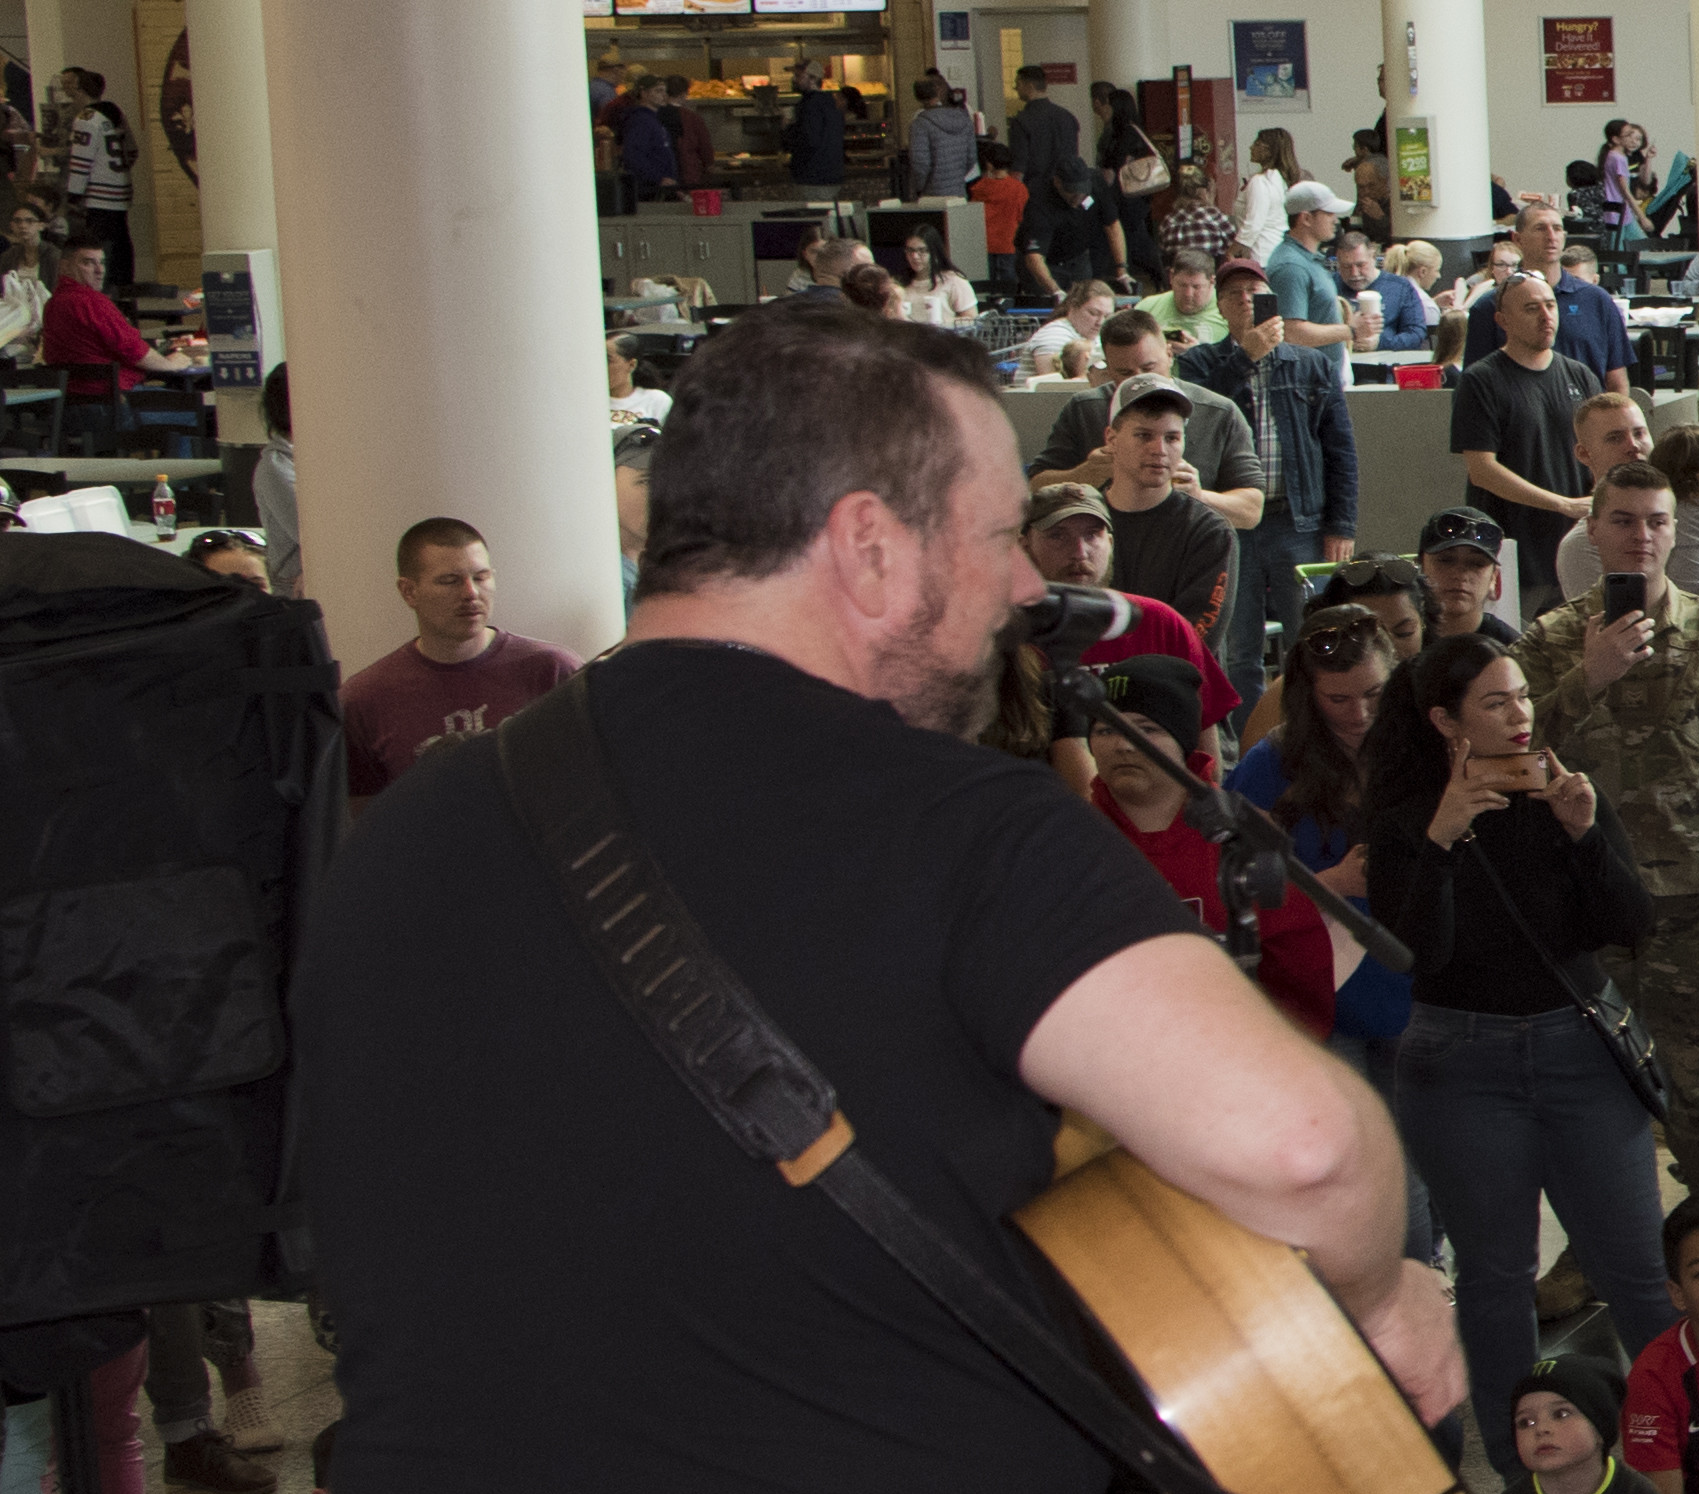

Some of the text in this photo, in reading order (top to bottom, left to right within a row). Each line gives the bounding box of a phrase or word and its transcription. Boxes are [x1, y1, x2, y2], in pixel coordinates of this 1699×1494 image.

[1556, 22, 1599, 34] Hungry?
[1562, 33, 1585, 43] Have
[1555, 43, 1601, 52] Delivered!
